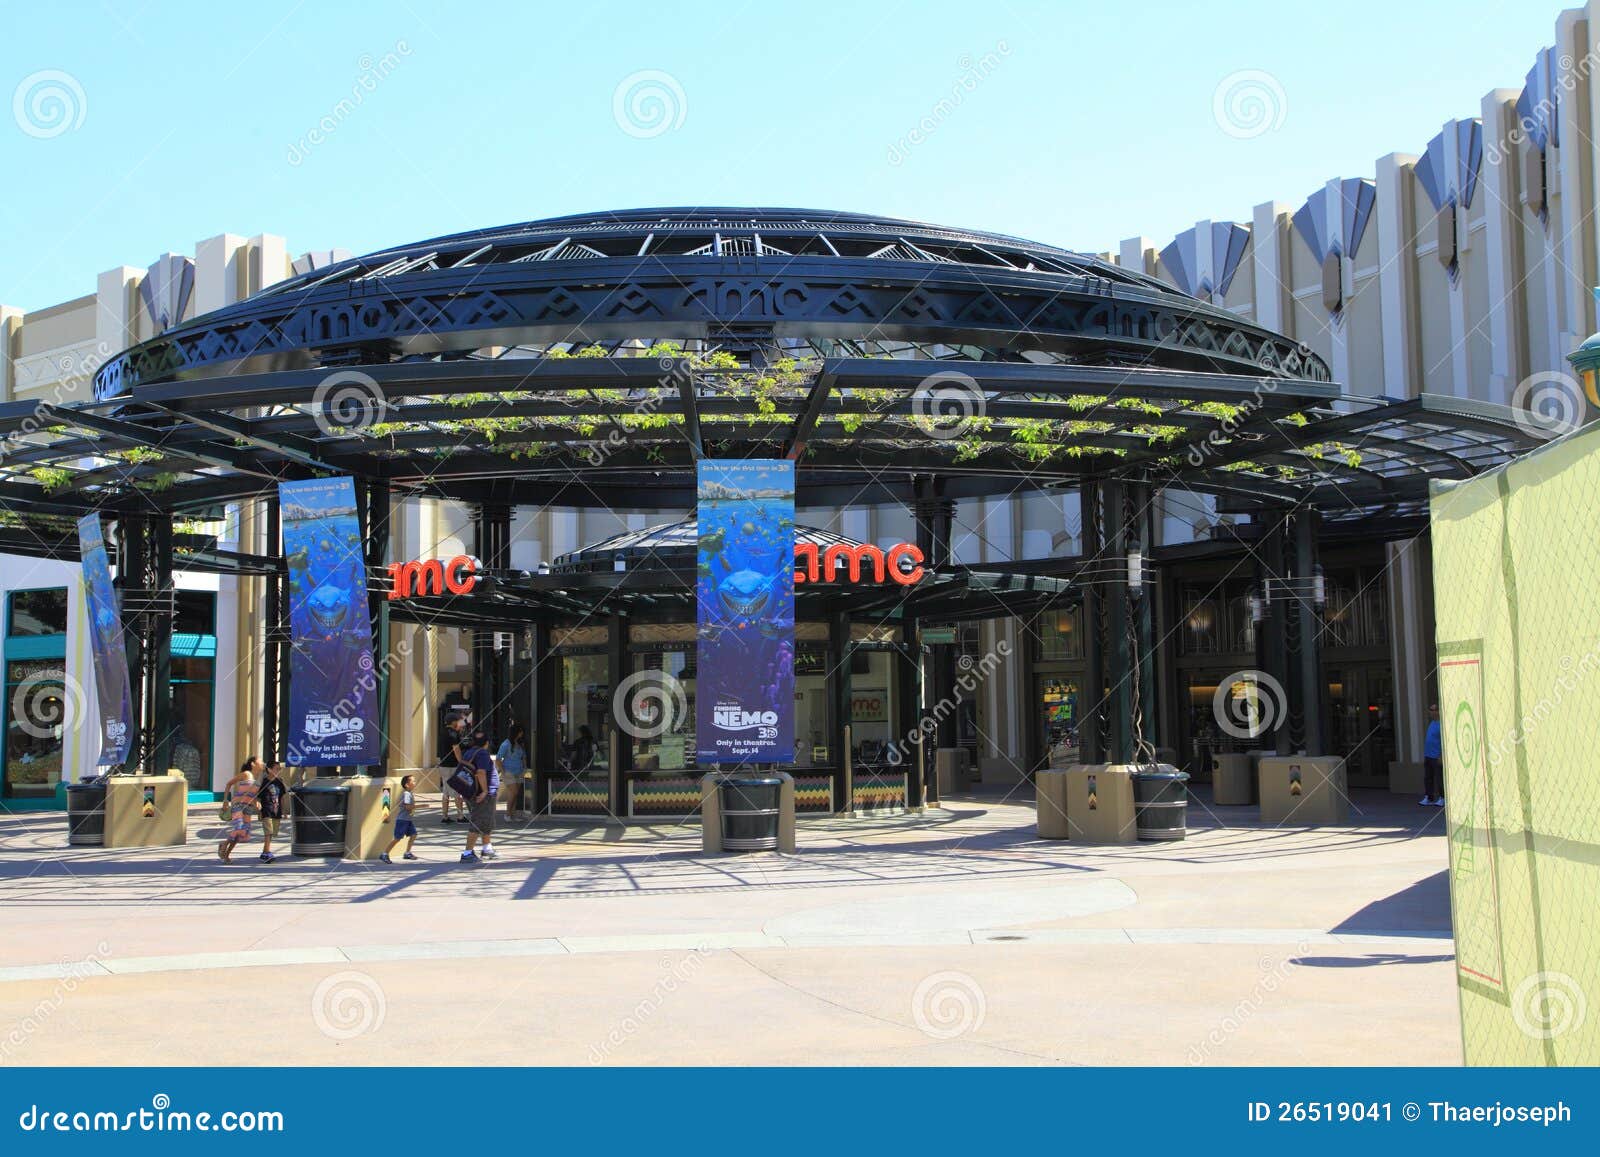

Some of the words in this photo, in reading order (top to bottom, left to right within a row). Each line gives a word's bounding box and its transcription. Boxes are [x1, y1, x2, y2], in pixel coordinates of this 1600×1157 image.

[305, 717, 364, 733] NEMO
[713, 711, 778, 727] NEMO
[758, 727, 778, 738] 3D
